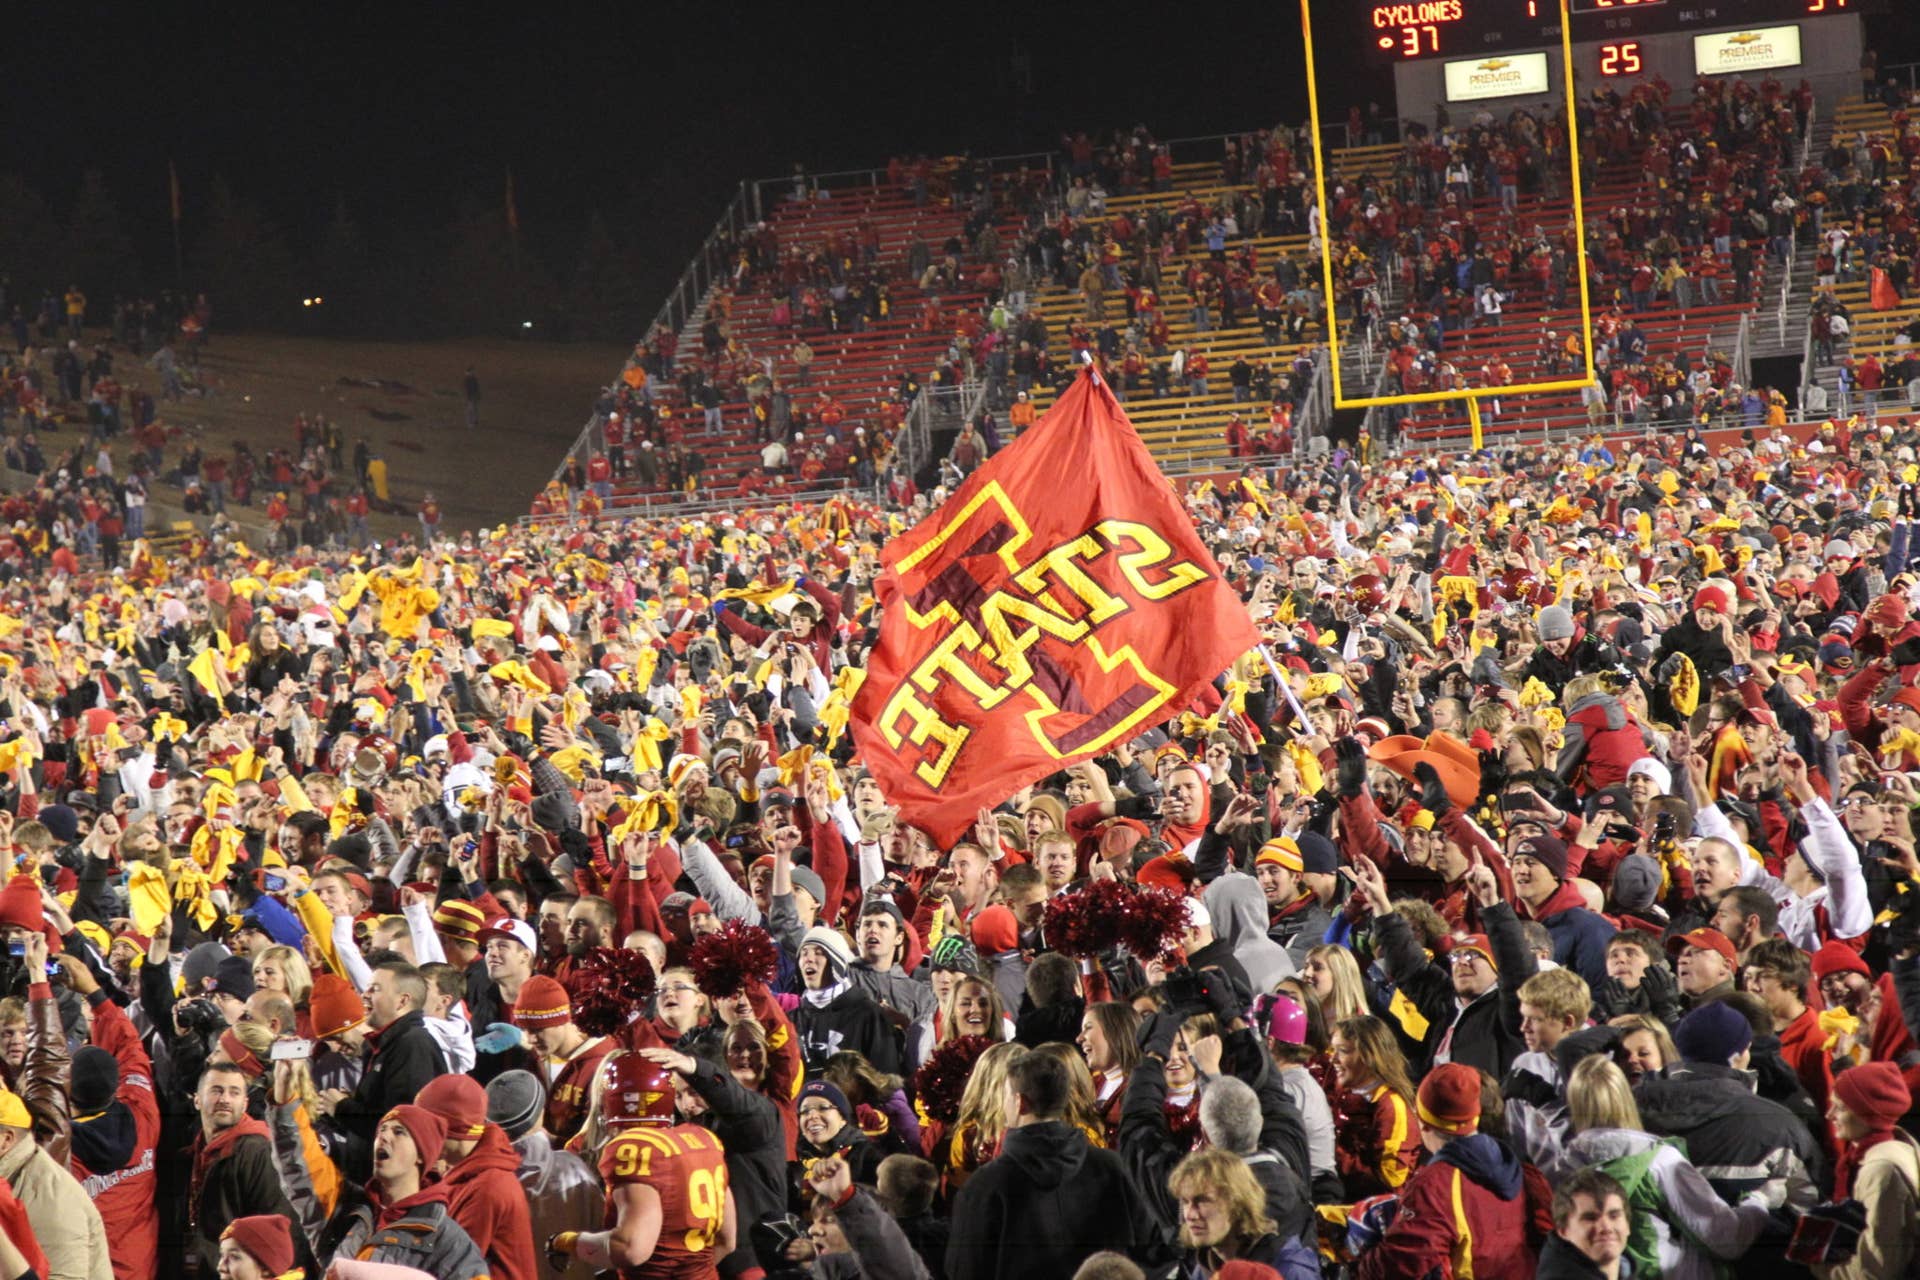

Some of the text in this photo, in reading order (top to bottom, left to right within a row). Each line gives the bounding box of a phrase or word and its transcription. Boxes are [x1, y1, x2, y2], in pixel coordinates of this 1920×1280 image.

[1373, 0, 1462, 28] CYCLONES
[1402, 25, 1439, 55] 37
[1718, 43, 1773, 58] PREMIER
[1601, 43, 1640, 74] 25
[1469, 71, 1521, 84] PREMIER
[613, 1143, 653, 1177] 91
